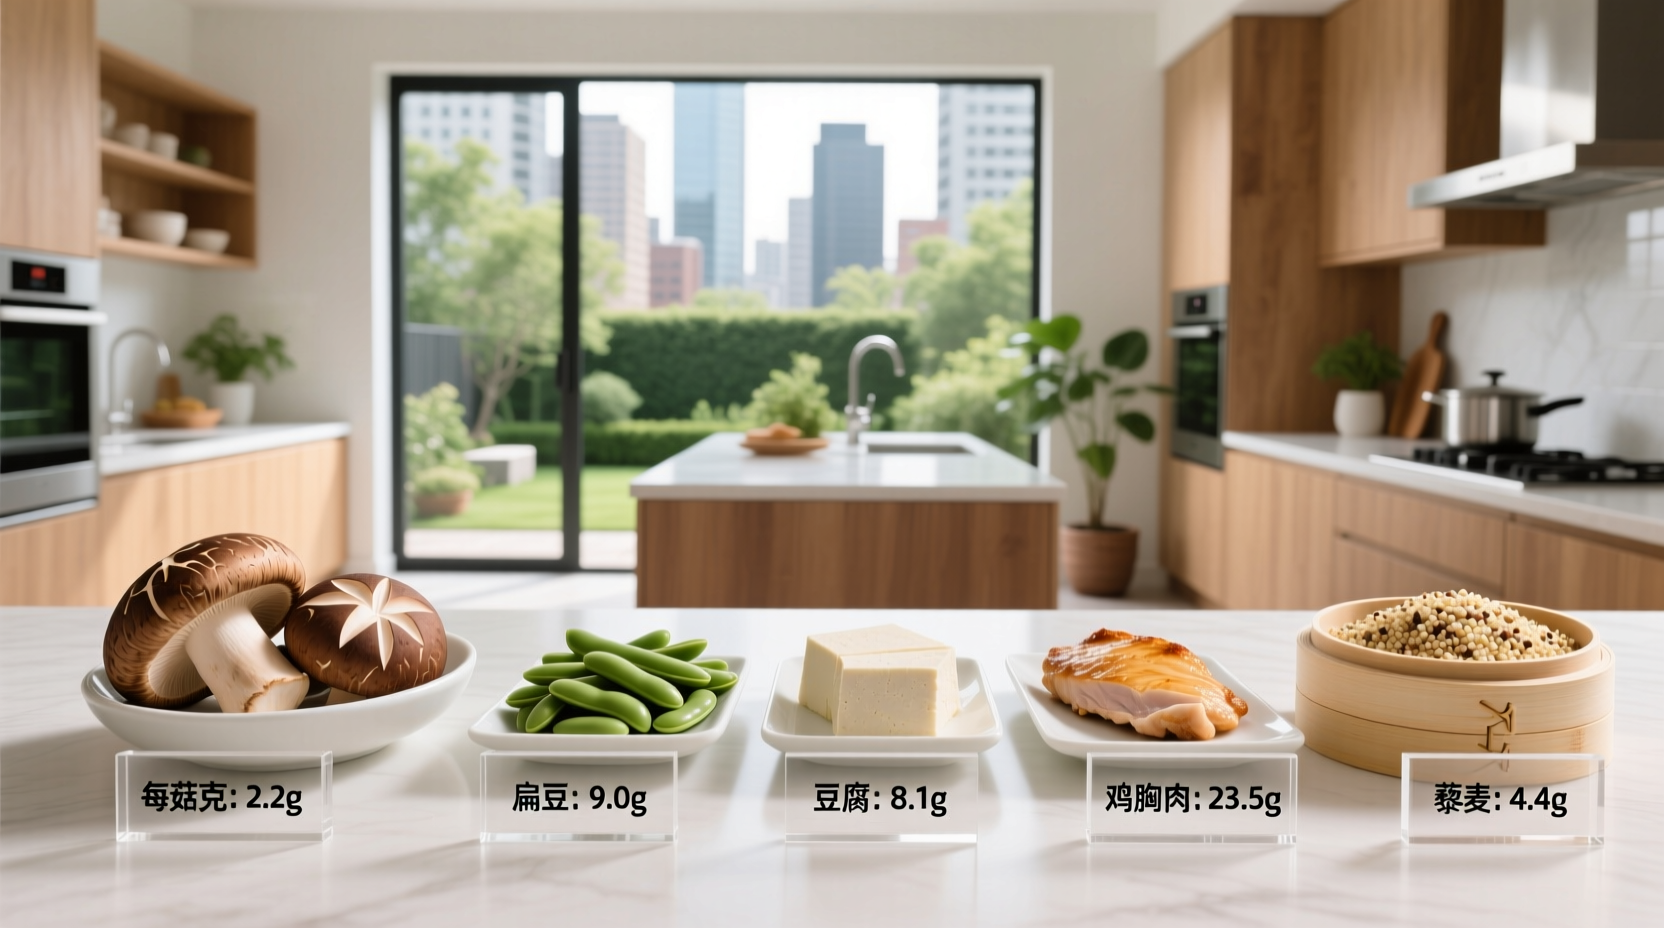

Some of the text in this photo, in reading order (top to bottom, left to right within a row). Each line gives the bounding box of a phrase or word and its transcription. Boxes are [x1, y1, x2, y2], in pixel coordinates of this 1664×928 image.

[246, 784, 302, 816] 2.2g
[589, 785, 647, 817] 9.0g
[890, 785, 947, 817] 8.1g
[1208, 785, 1281, 817] 23.5g
[1509, 786, 1567, 818] 4.4g
